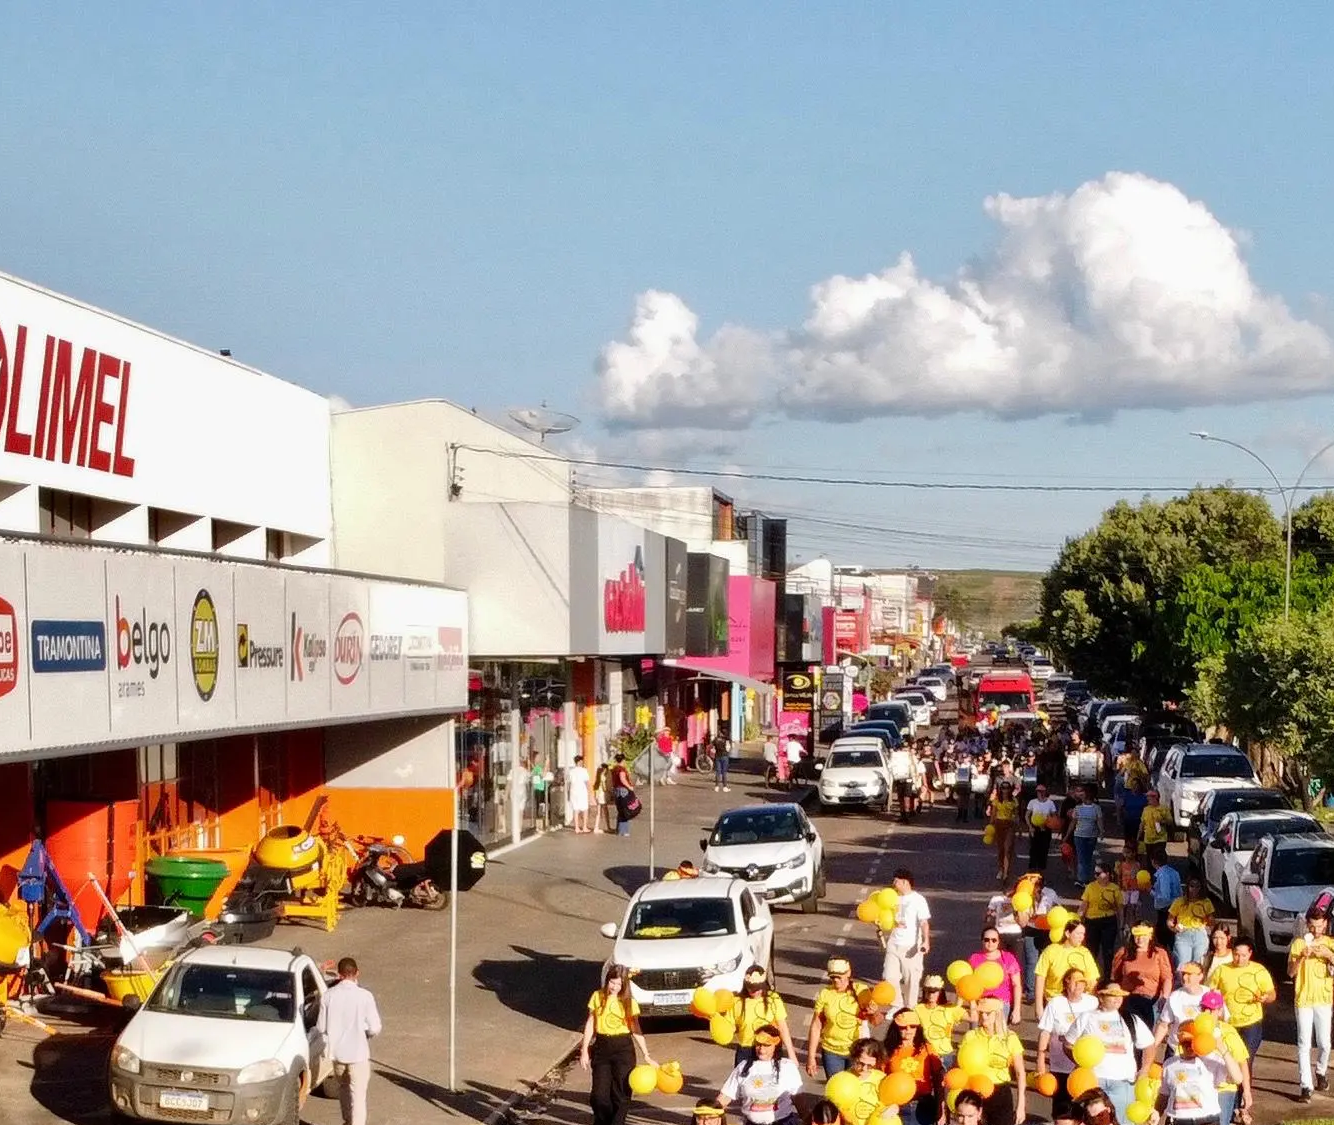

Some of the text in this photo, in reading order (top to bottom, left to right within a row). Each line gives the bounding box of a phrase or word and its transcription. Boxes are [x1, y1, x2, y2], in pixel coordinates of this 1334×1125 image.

[37, 635, 102, 661] TRAMONTINA
[116, 594, 170, 680] belgo
[250, 640, 284, 669] Pressure
